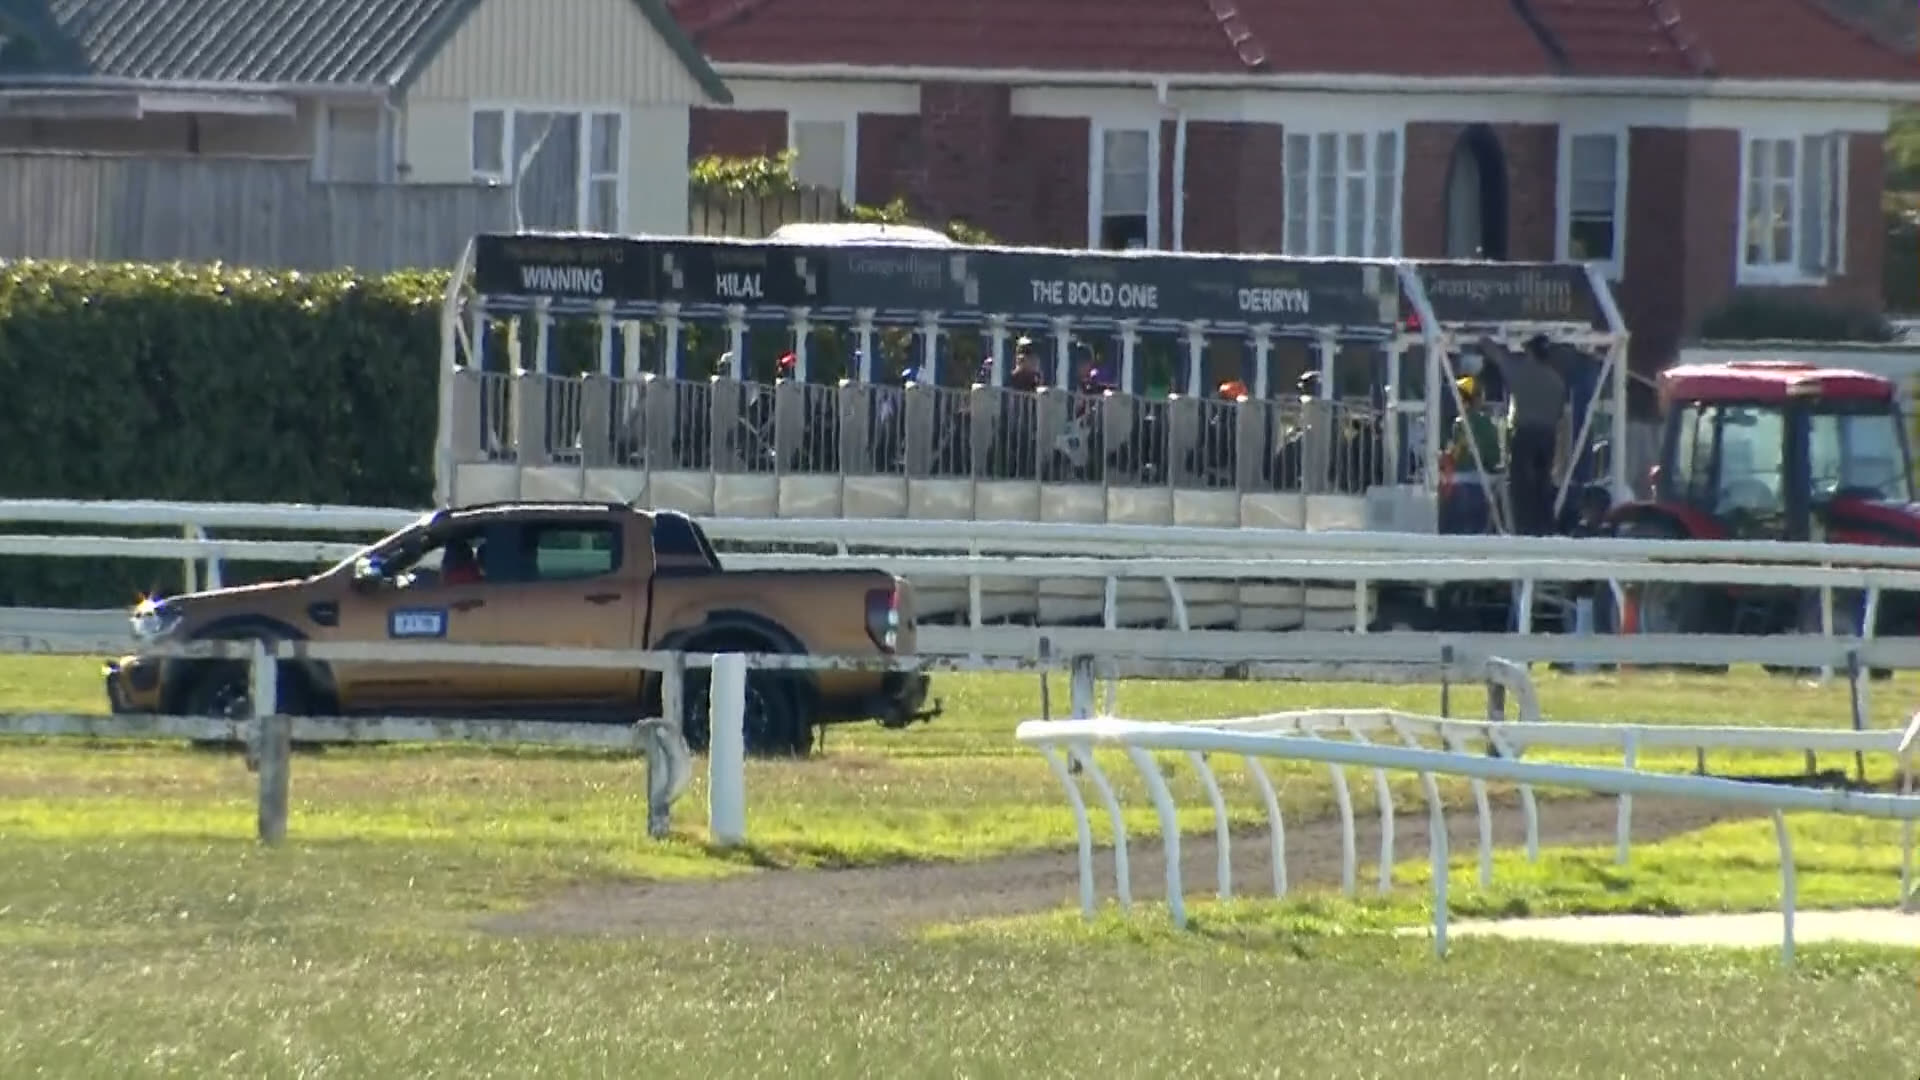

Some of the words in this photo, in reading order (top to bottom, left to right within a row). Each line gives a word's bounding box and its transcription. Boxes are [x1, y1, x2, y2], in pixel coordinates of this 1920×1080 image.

[521, 265, 604, 292] WINNING
[716, 272, 764, 297] HILAL
[1030, 279, 1064, 305] THE
[1068, 281, 1114, 307] BOLD
[1118, 283, 1158, 309] ONE
[1238, 287, 1310, 314] DERRYN
